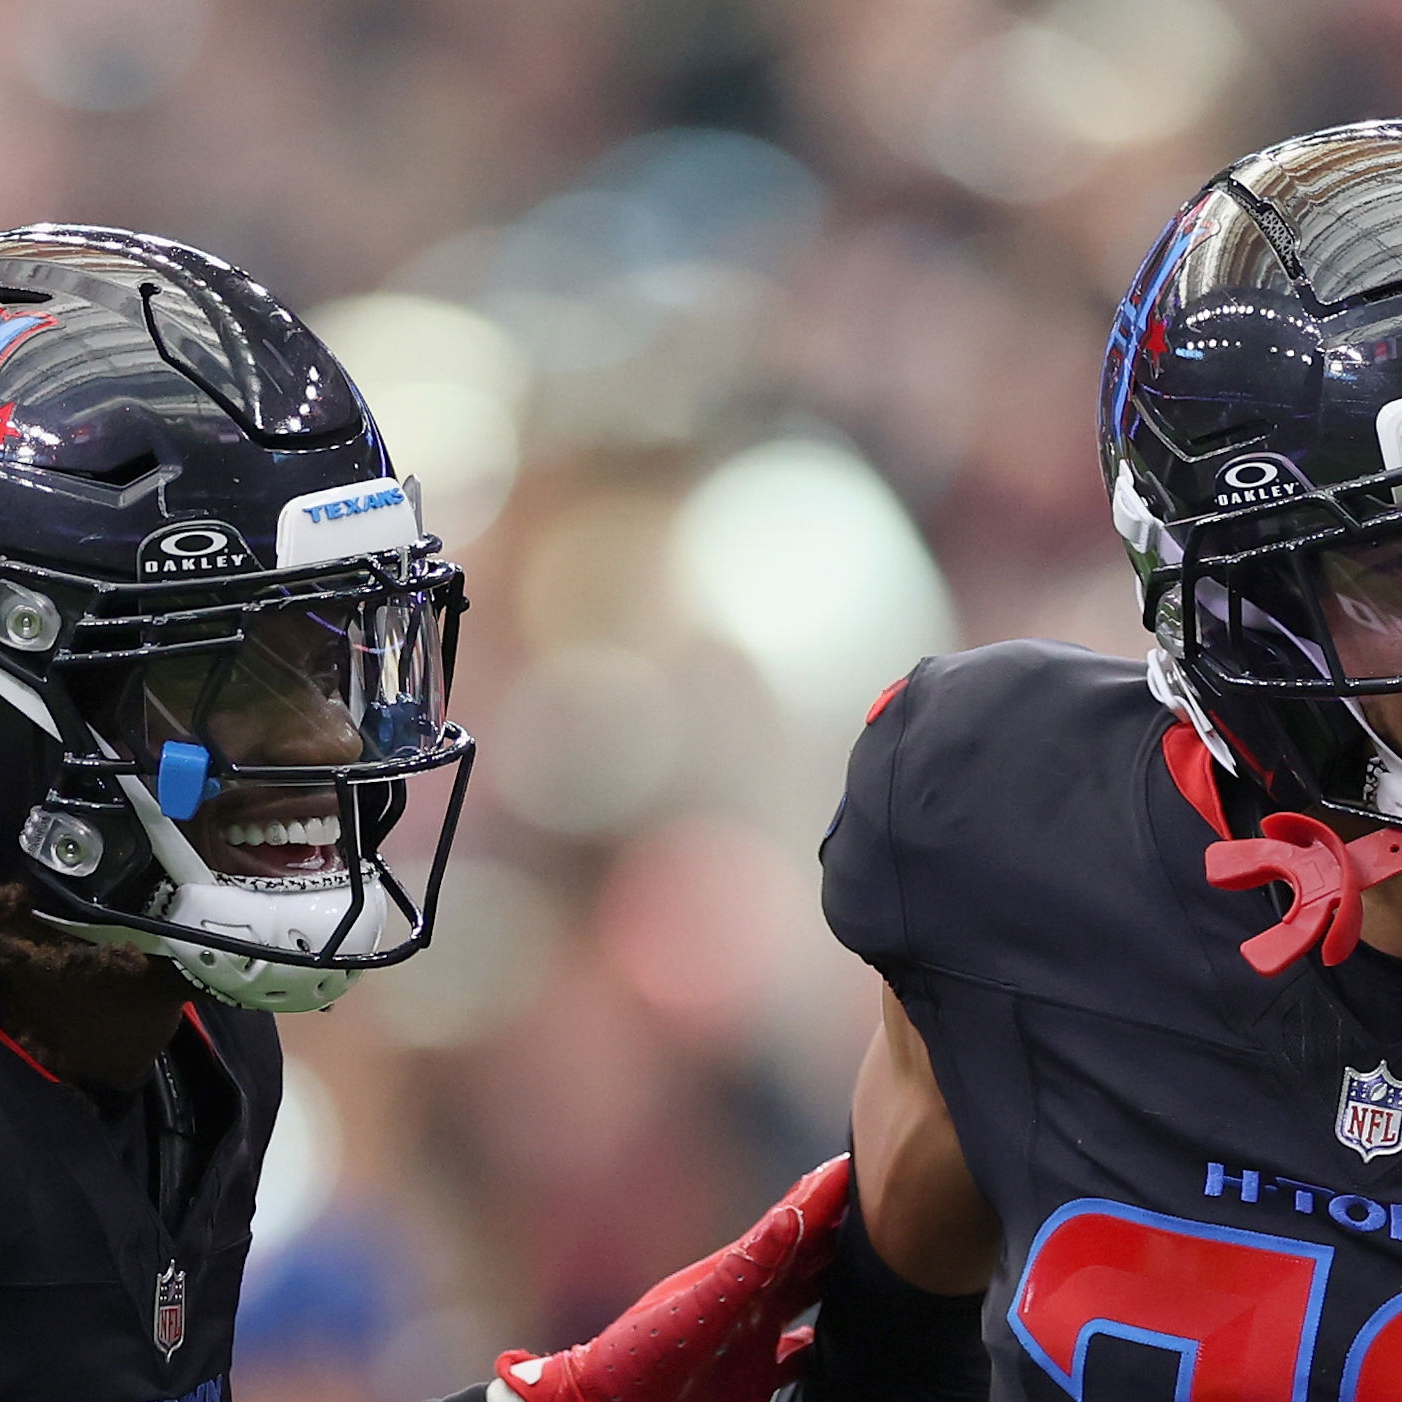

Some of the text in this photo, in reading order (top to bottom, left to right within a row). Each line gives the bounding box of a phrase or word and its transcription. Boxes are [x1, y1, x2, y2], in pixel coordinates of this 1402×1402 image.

[303, 487, 405, 524] TEXANS
[1217, 482, 1296, 506] OAKLEY
[144, 553, 245, 573] OAKLEY
[1347, 1105, 1397, 1144] NFL
[159, 1306, 183, 1344] NFL
